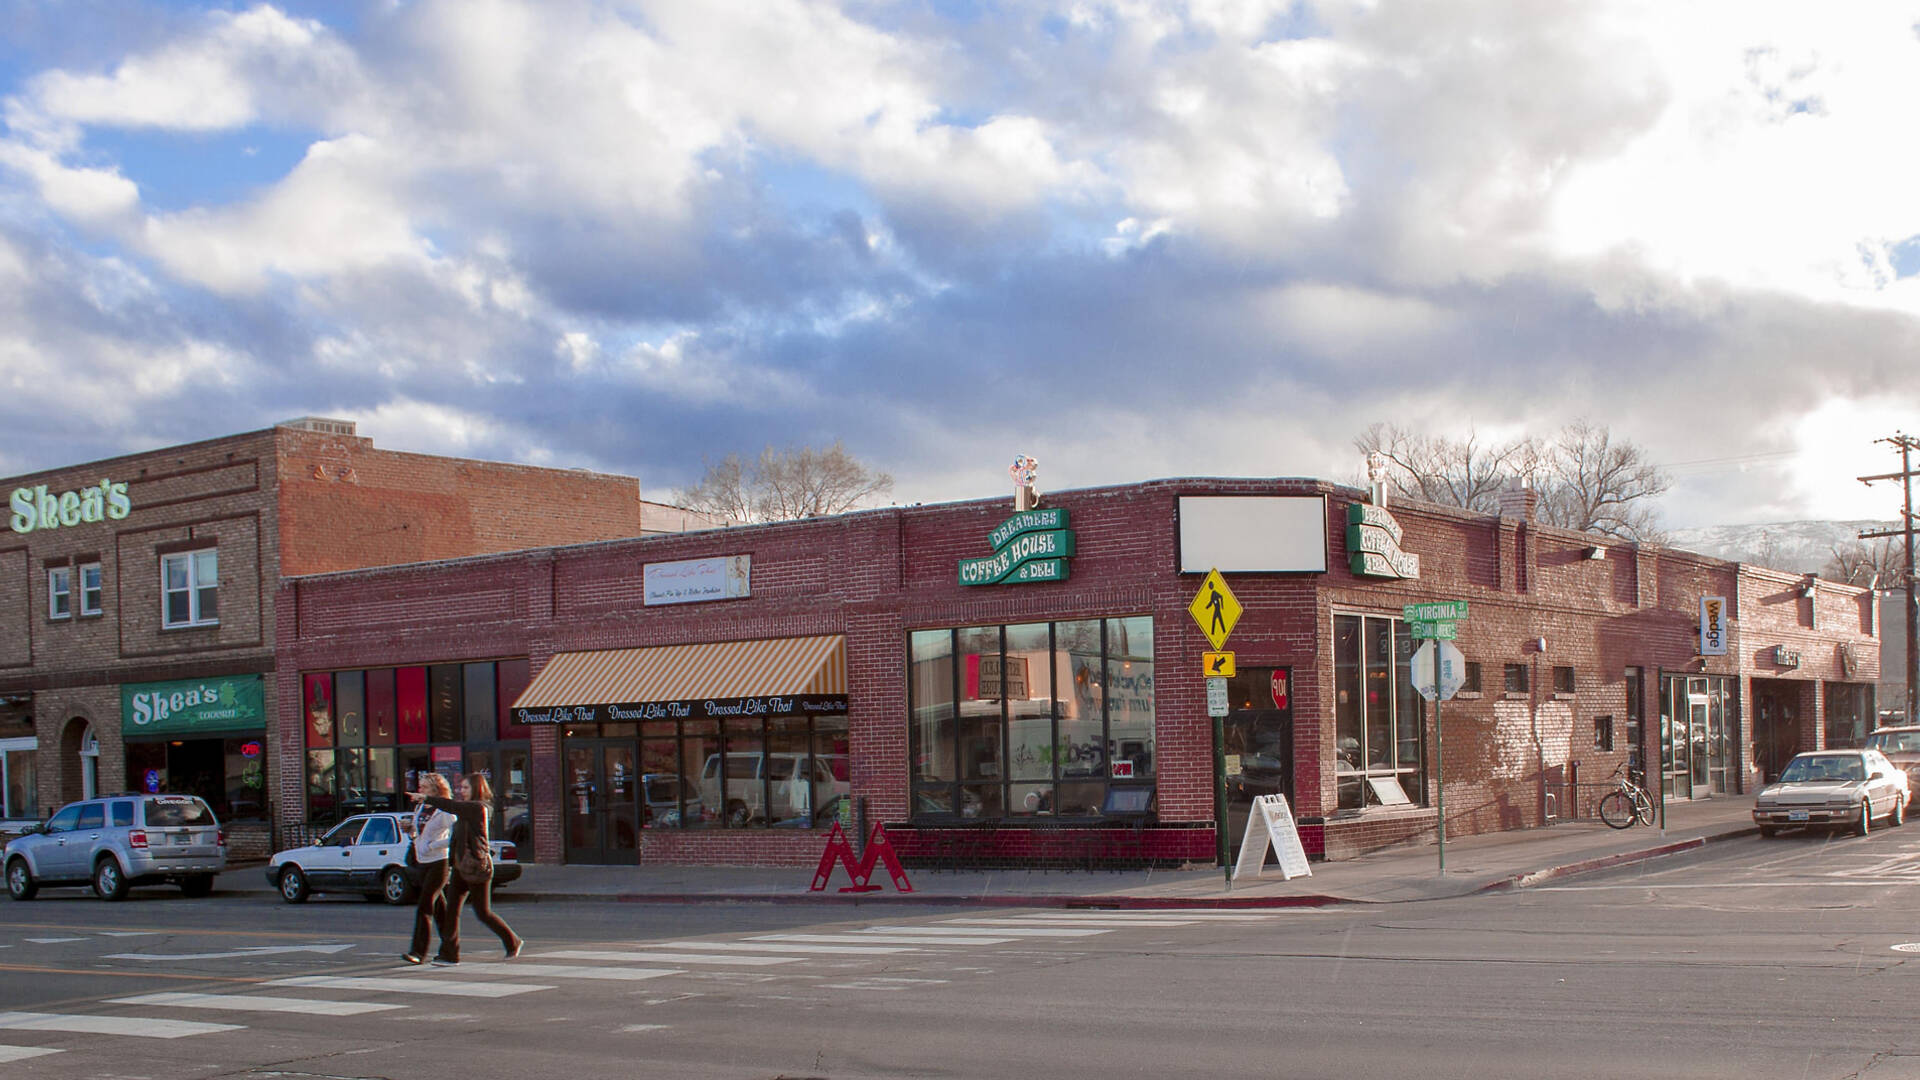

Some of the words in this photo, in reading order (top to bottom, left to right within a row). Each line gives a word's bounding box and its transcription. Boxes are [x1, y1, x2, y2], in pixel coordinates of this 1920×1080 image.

[10, 478, 131, 534] Shea's
[992, 511, 1057, 546] DREAMERS
[961, 551, 1010, 581] COFFEE
[1011, 534, 1056, 562] HOUSE
[1030, 562, 1056, 577] DELI
[1418, 604, 1457, 619] VIRGINIA
[1706, 601, 1722, 648] wedge
[132, 685, 218, 725] Shea's
[518, 708, 551, 724] Dressed
[551, 707, 572, 723] Like
[574, 706, 595, 721] That
[608, 704, 643, 720] Dressed
[643, 703, 667, 719] Like
[668, 702, 690, 717] That
[704, 700, 742, 716] Dressed
[742, 698, 767, 715] Like
[769, 697, 793, 713] That
